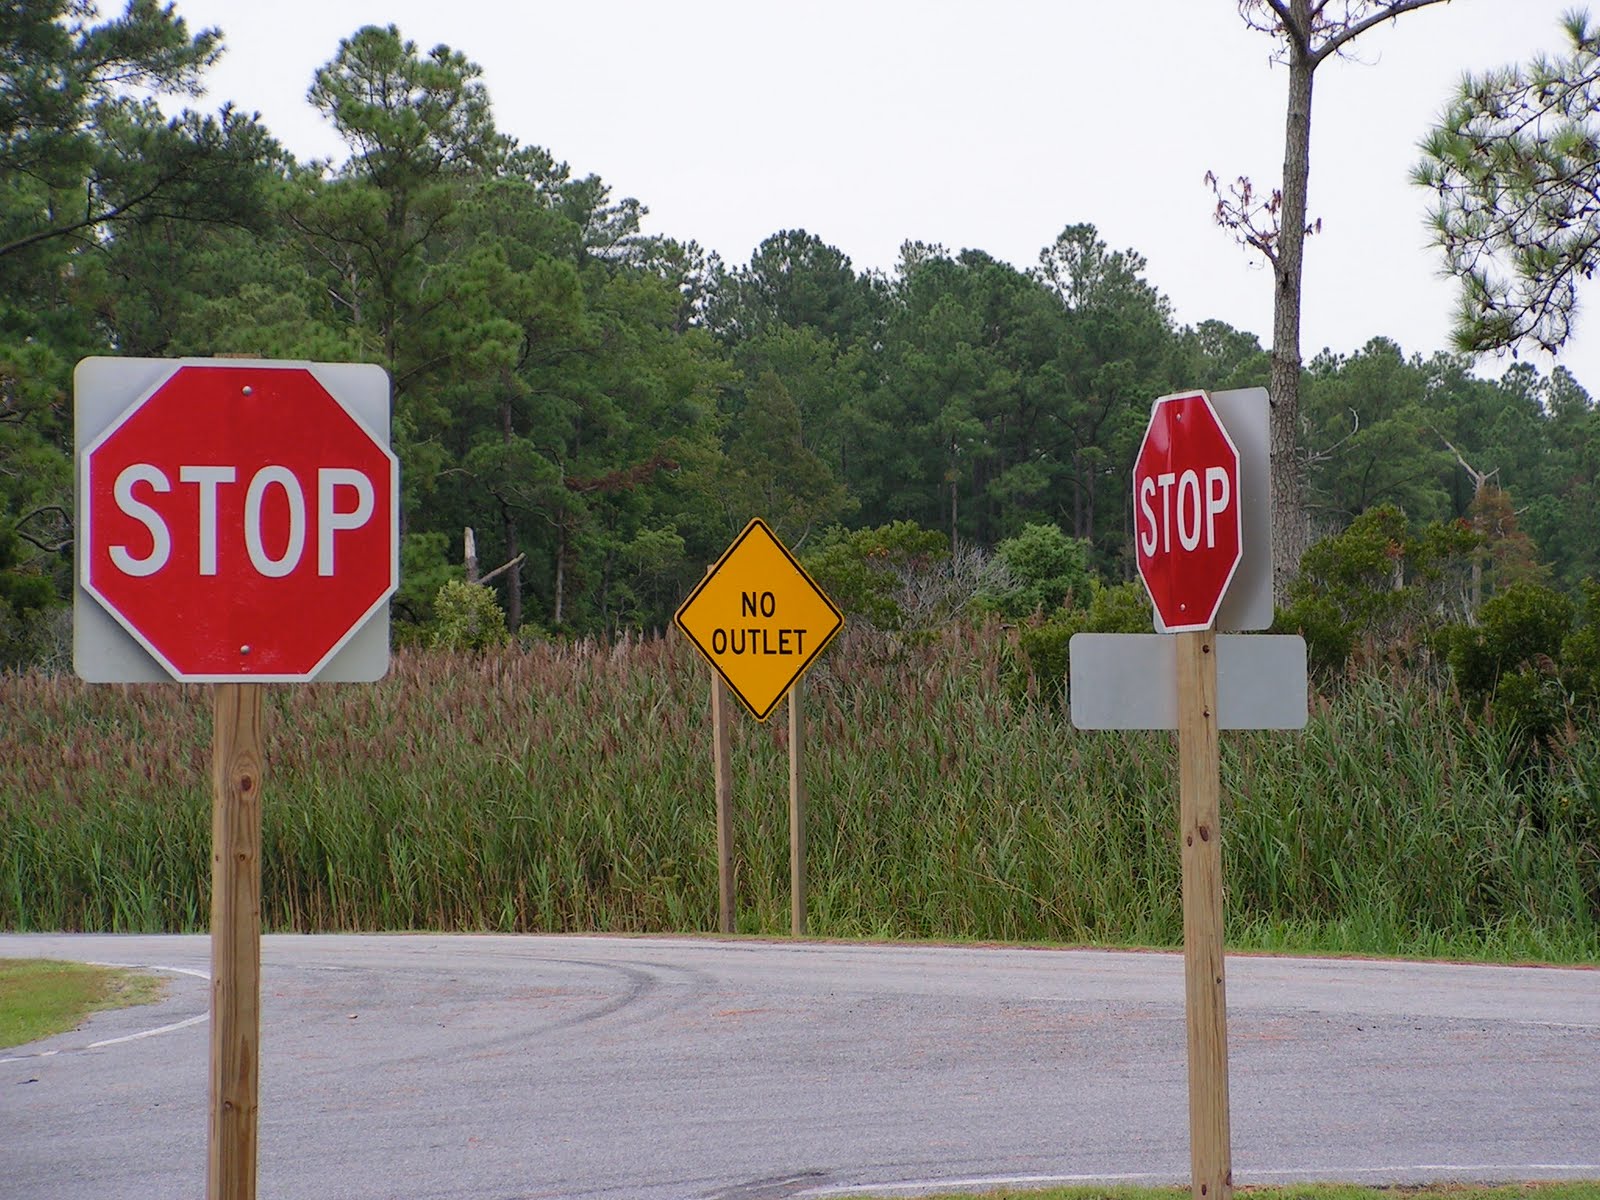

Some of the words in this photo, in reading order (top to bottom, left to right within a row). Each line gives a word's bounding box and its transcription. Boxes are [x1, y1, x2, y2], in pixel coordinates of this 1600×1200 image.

[108, 463, 375, 578] STOP
[1139, 466, 1230, 558] STOP
[741, 591, 776, 618] NO
[712, 628, 807, 656] OUTLET
